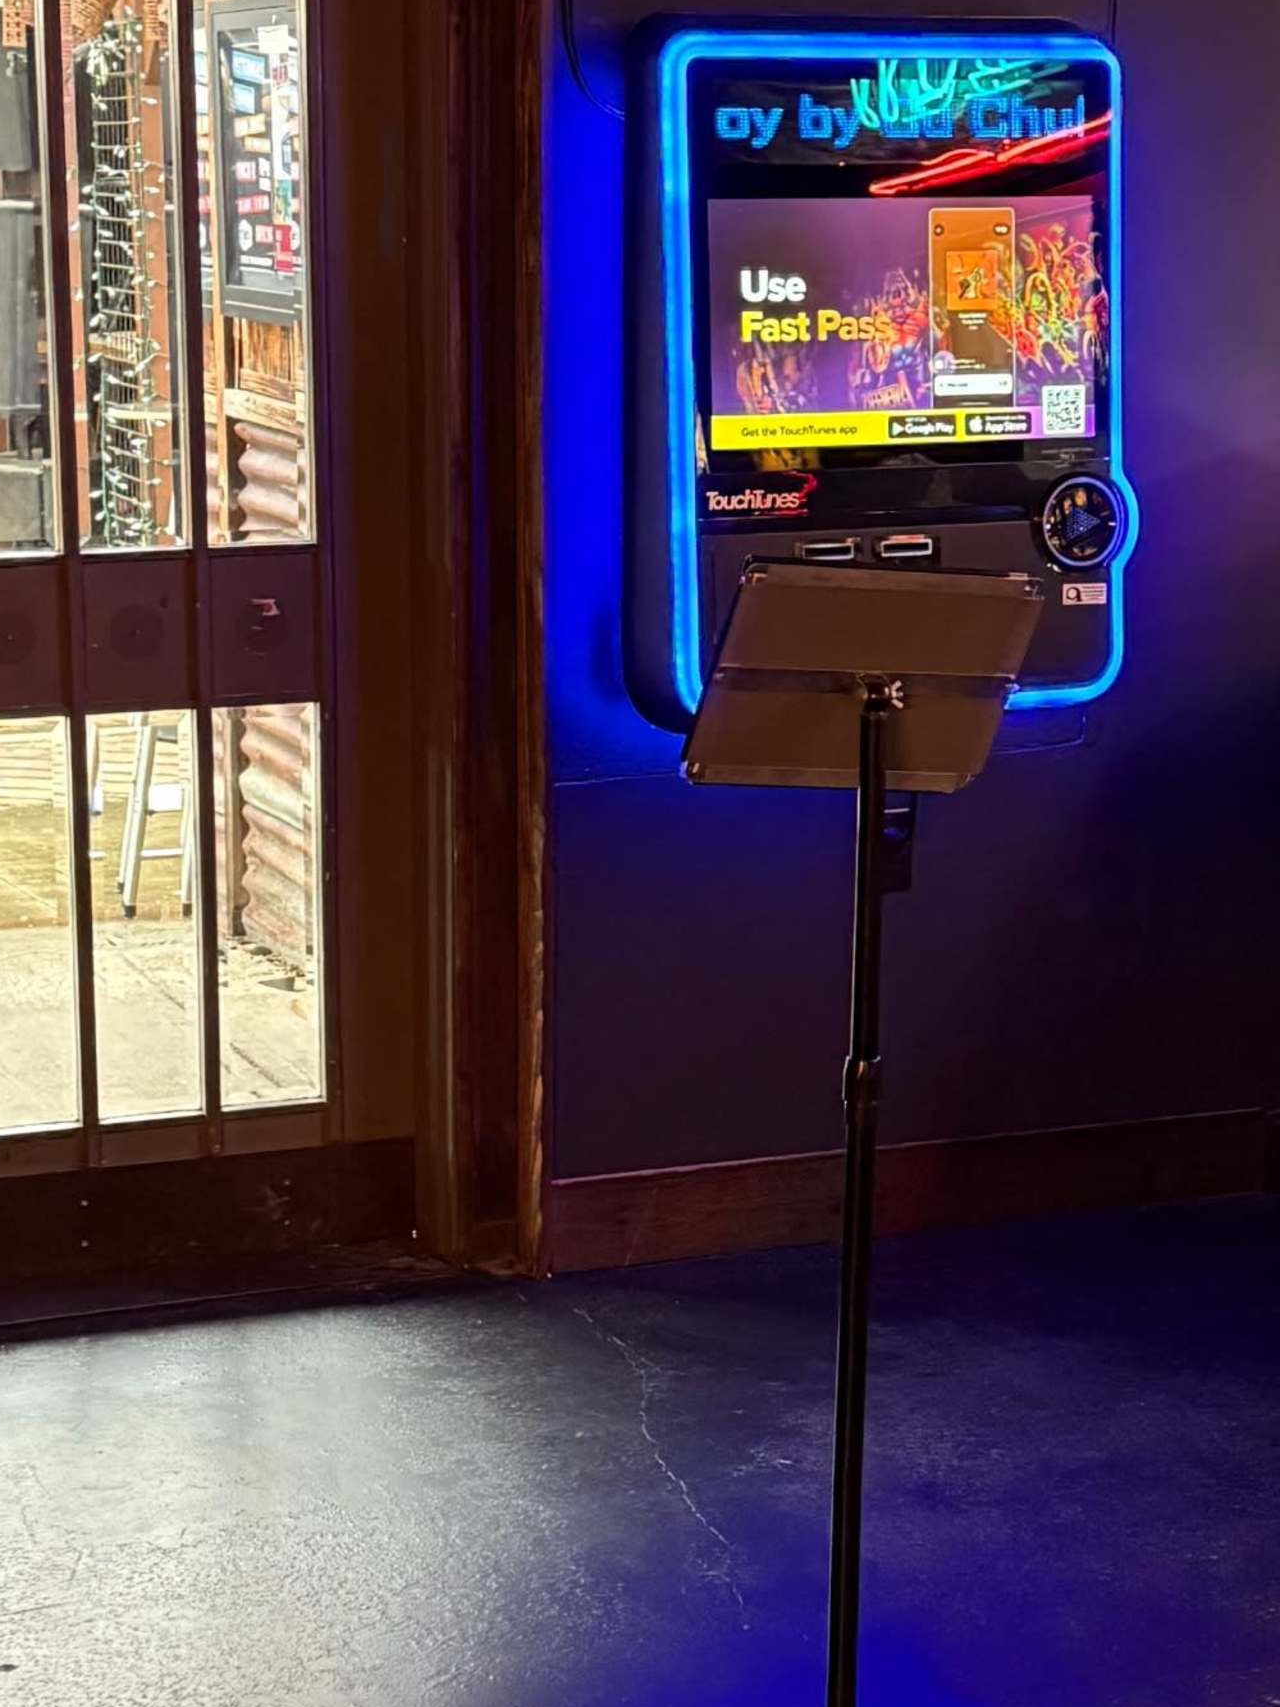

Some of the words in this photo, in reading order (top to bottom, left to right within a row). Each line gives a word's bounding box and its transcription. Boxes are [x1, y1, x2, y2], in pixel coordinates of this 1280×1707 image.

[799, 93, 858, 150] by
[740, 269, 807, 303] Use
[741, 310, 811, 342] Fast
[817, 309, 894, 342] Pass
[741, 427, 760, 438] Get
[761, 426, 777, 437] the
[780, 424, 837, 436] TouchTunes
[839, 425, 858, 436] app
[706, 489, 800, 511] TouchTunes
